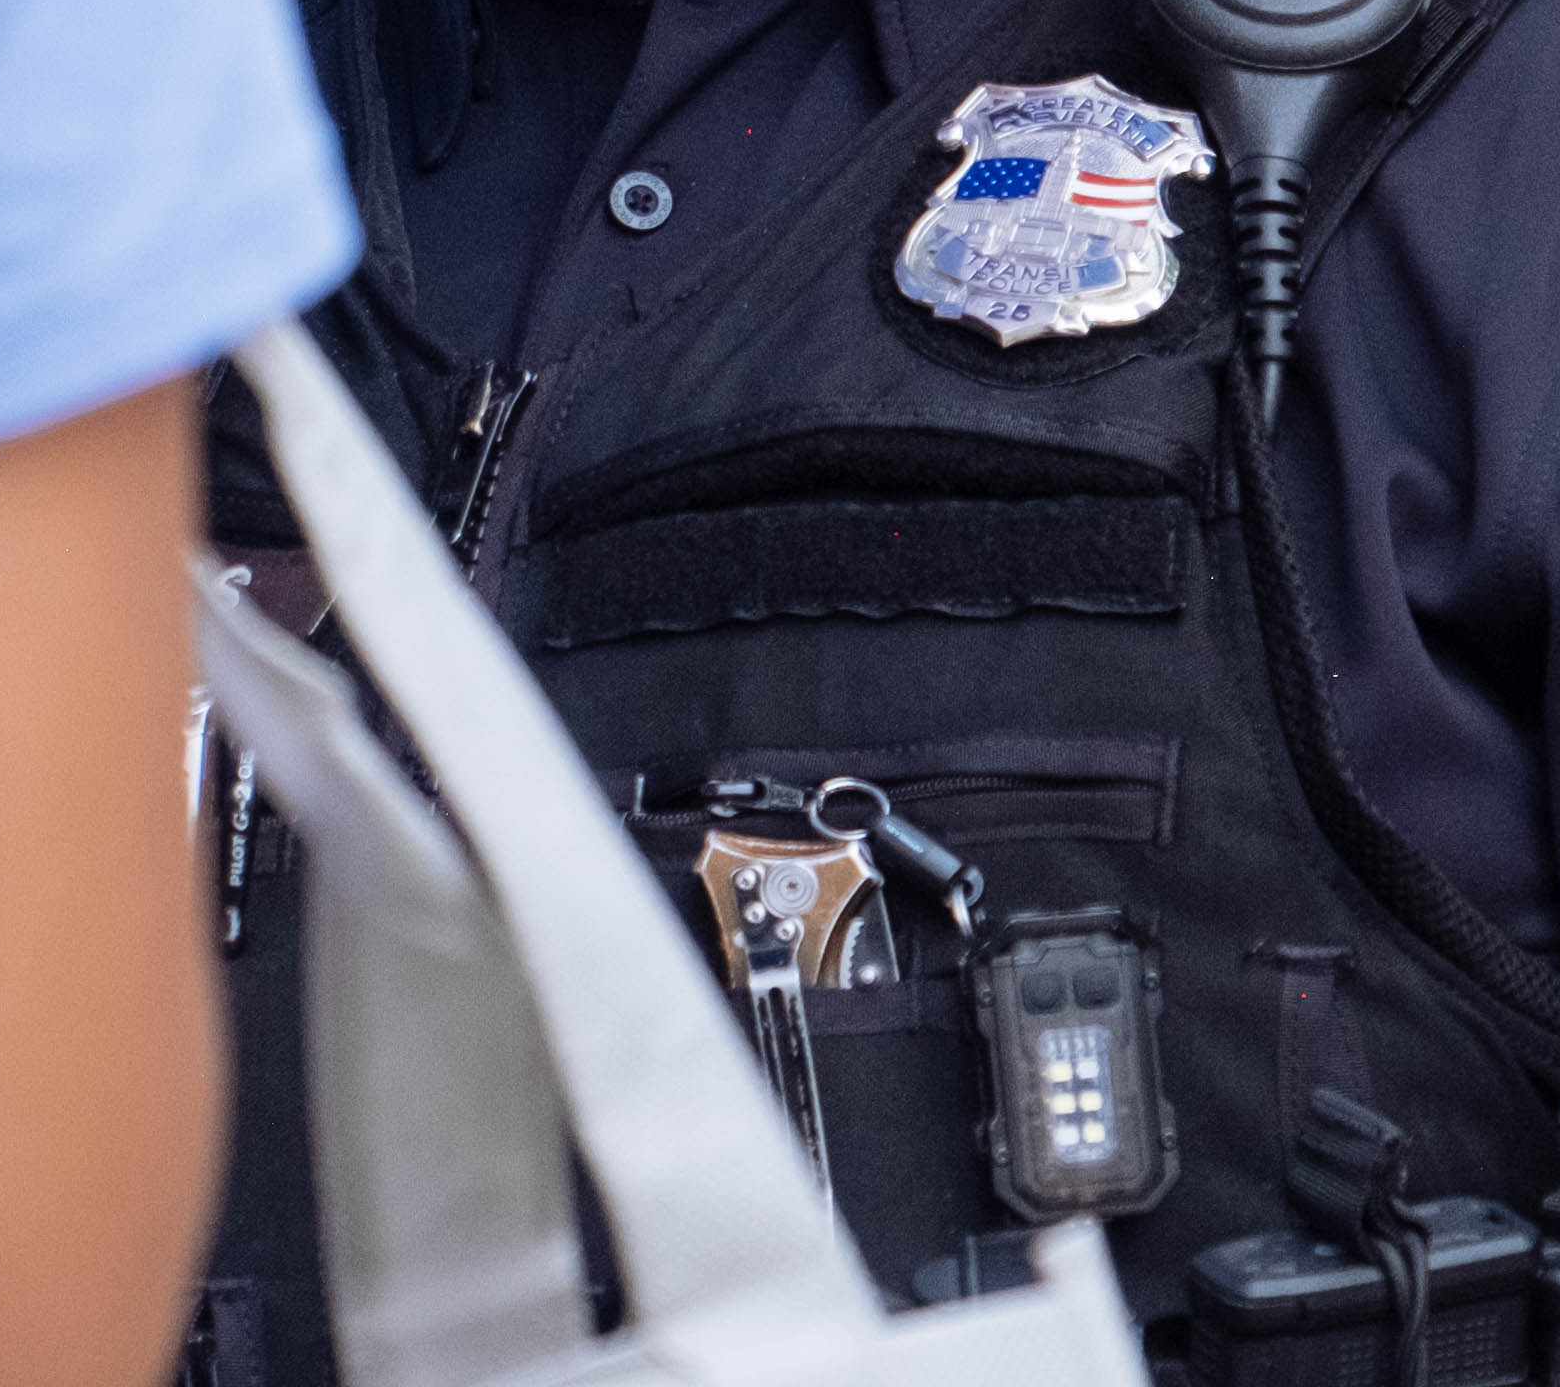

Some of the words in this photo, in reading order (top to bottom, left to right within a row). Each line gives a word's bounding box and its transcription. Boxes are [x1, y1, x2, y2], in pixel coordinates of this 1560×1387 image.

[998, 111, 1153, 151] EVELAND
[1021, 97, 1145, 127] GREATER
[968, 270, 1072, 294] POLICE
[232, 784, 253, 830] G-2
[229, 834, 246, 887] PILOT
